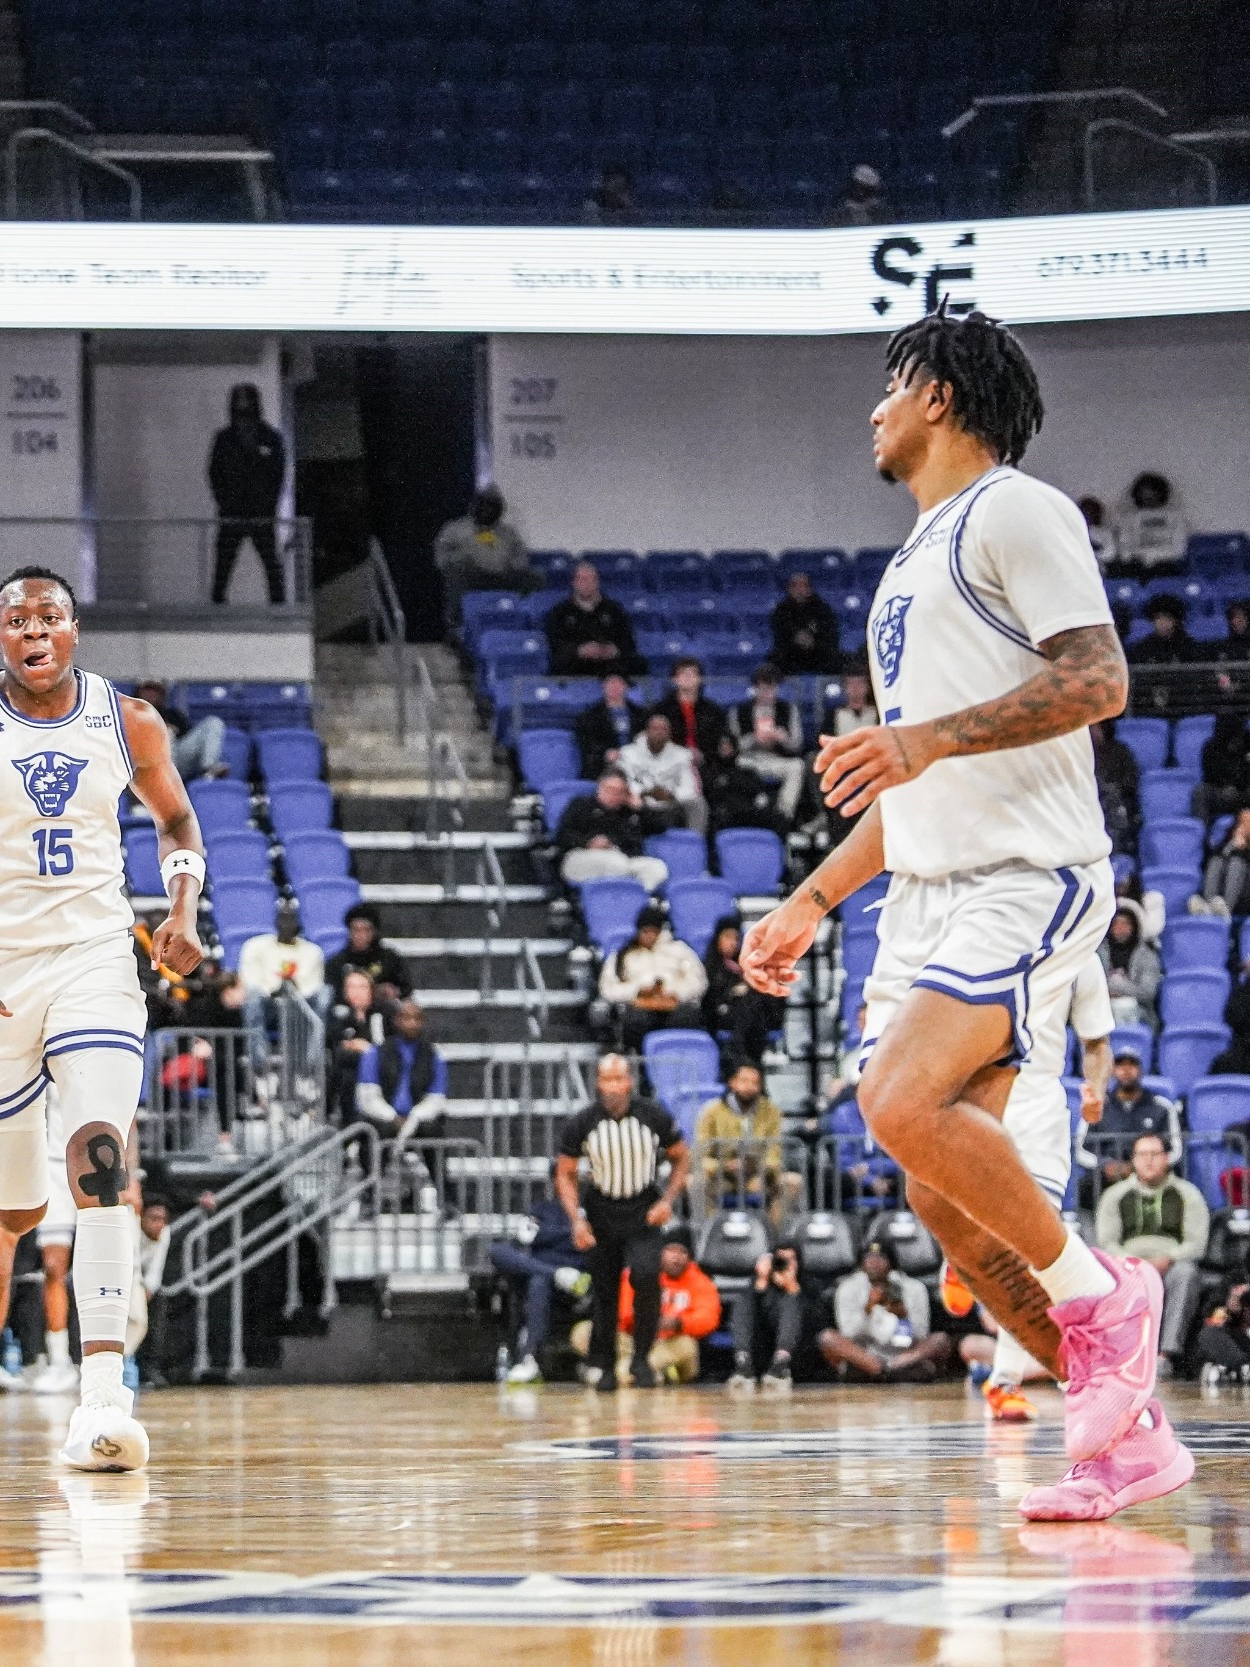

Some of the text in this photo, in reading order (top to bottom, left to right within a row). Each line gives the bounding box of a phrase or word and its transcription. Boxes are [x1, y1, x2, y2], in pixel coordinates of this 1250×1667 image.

[88, 263, 161, 285] Team
[170, 263, 270, 286] Realtor
[13, 374, 62, 400] 206
[11, 429, 58, 455] 104
[511, 431, 557, 458] 105
[85, 715, 112, 728] SBC
[32, 828, 75, 876] 15
